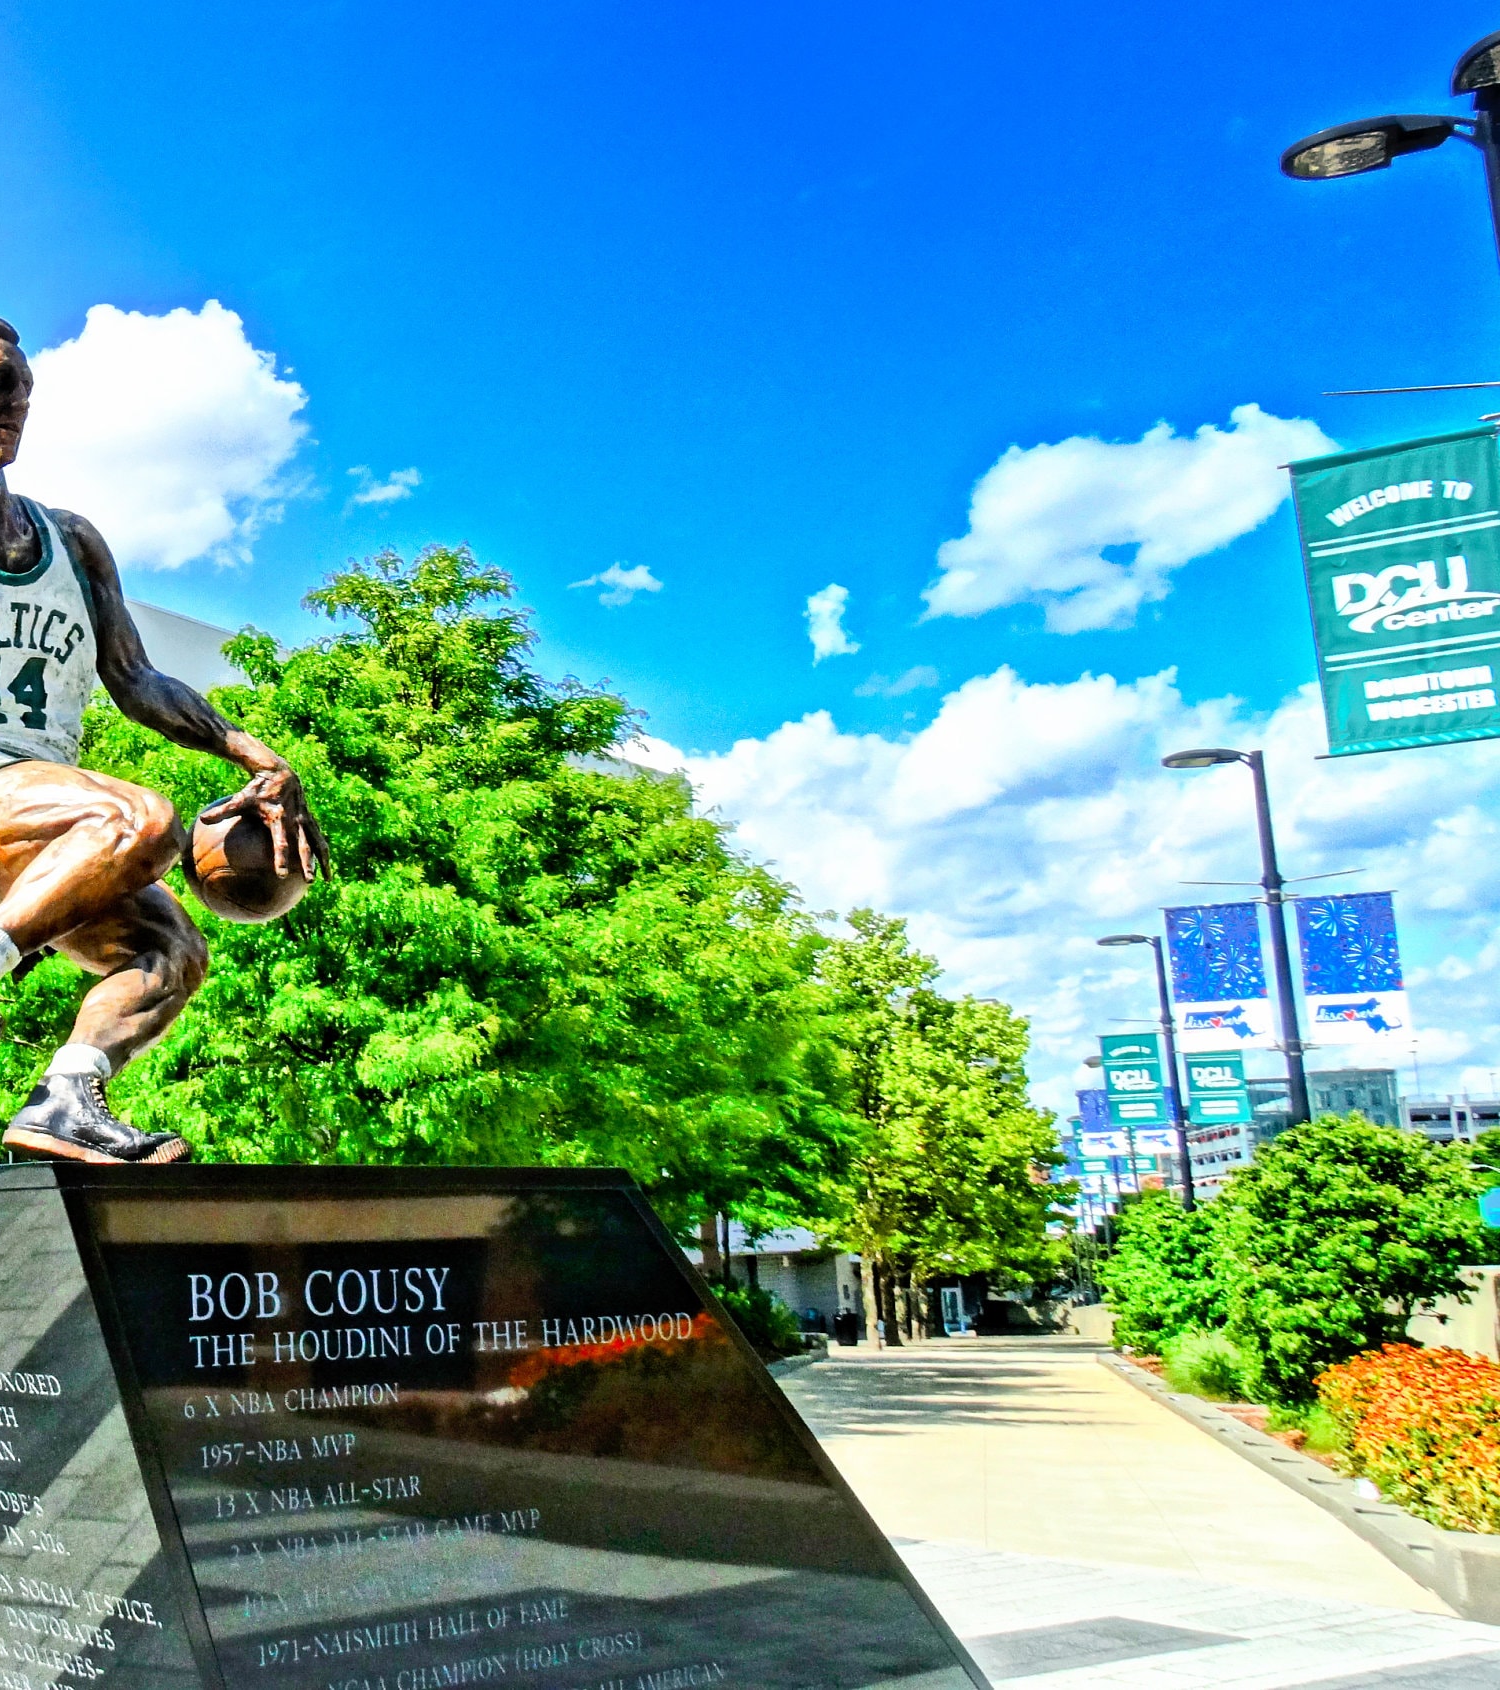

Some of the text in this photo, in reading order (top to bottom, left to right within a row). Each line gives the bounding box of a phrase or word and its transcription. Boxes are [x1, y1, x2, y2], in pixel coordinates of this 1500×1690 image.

[1325, 479, 1474, 528] WELCOME TO
[1331, 555, 1469, 617] DCU
[188, 1267, 450, 1321] BOB COUSY
[189, 1311, 694, 1368] THE HOUDINI OF THE HARDWOOD
[184, 1382, 399, 1419] 6 X NBA CHAMPION
[200, 1433, 356, 1469] 1957-NBA MVP
[214, 1475, 422, 1518] 13 X NBA ALL-STAR
[3, 1524, 24, 1547] IN
[433, 1513, 491, 1542] GAME
[501, 1508, 541, 1532] MVP
[19, 1576, 80, 1608] SOCIAL
[6, 1606, 116, 1651] DOCTORATES
[257, 1597, 570, 1667] 1971-NAISMITH HALL OF FAME
[398, 1655, 506, 1690] CHAMPION
[578, 1628, 642, 1661] CROSS)
